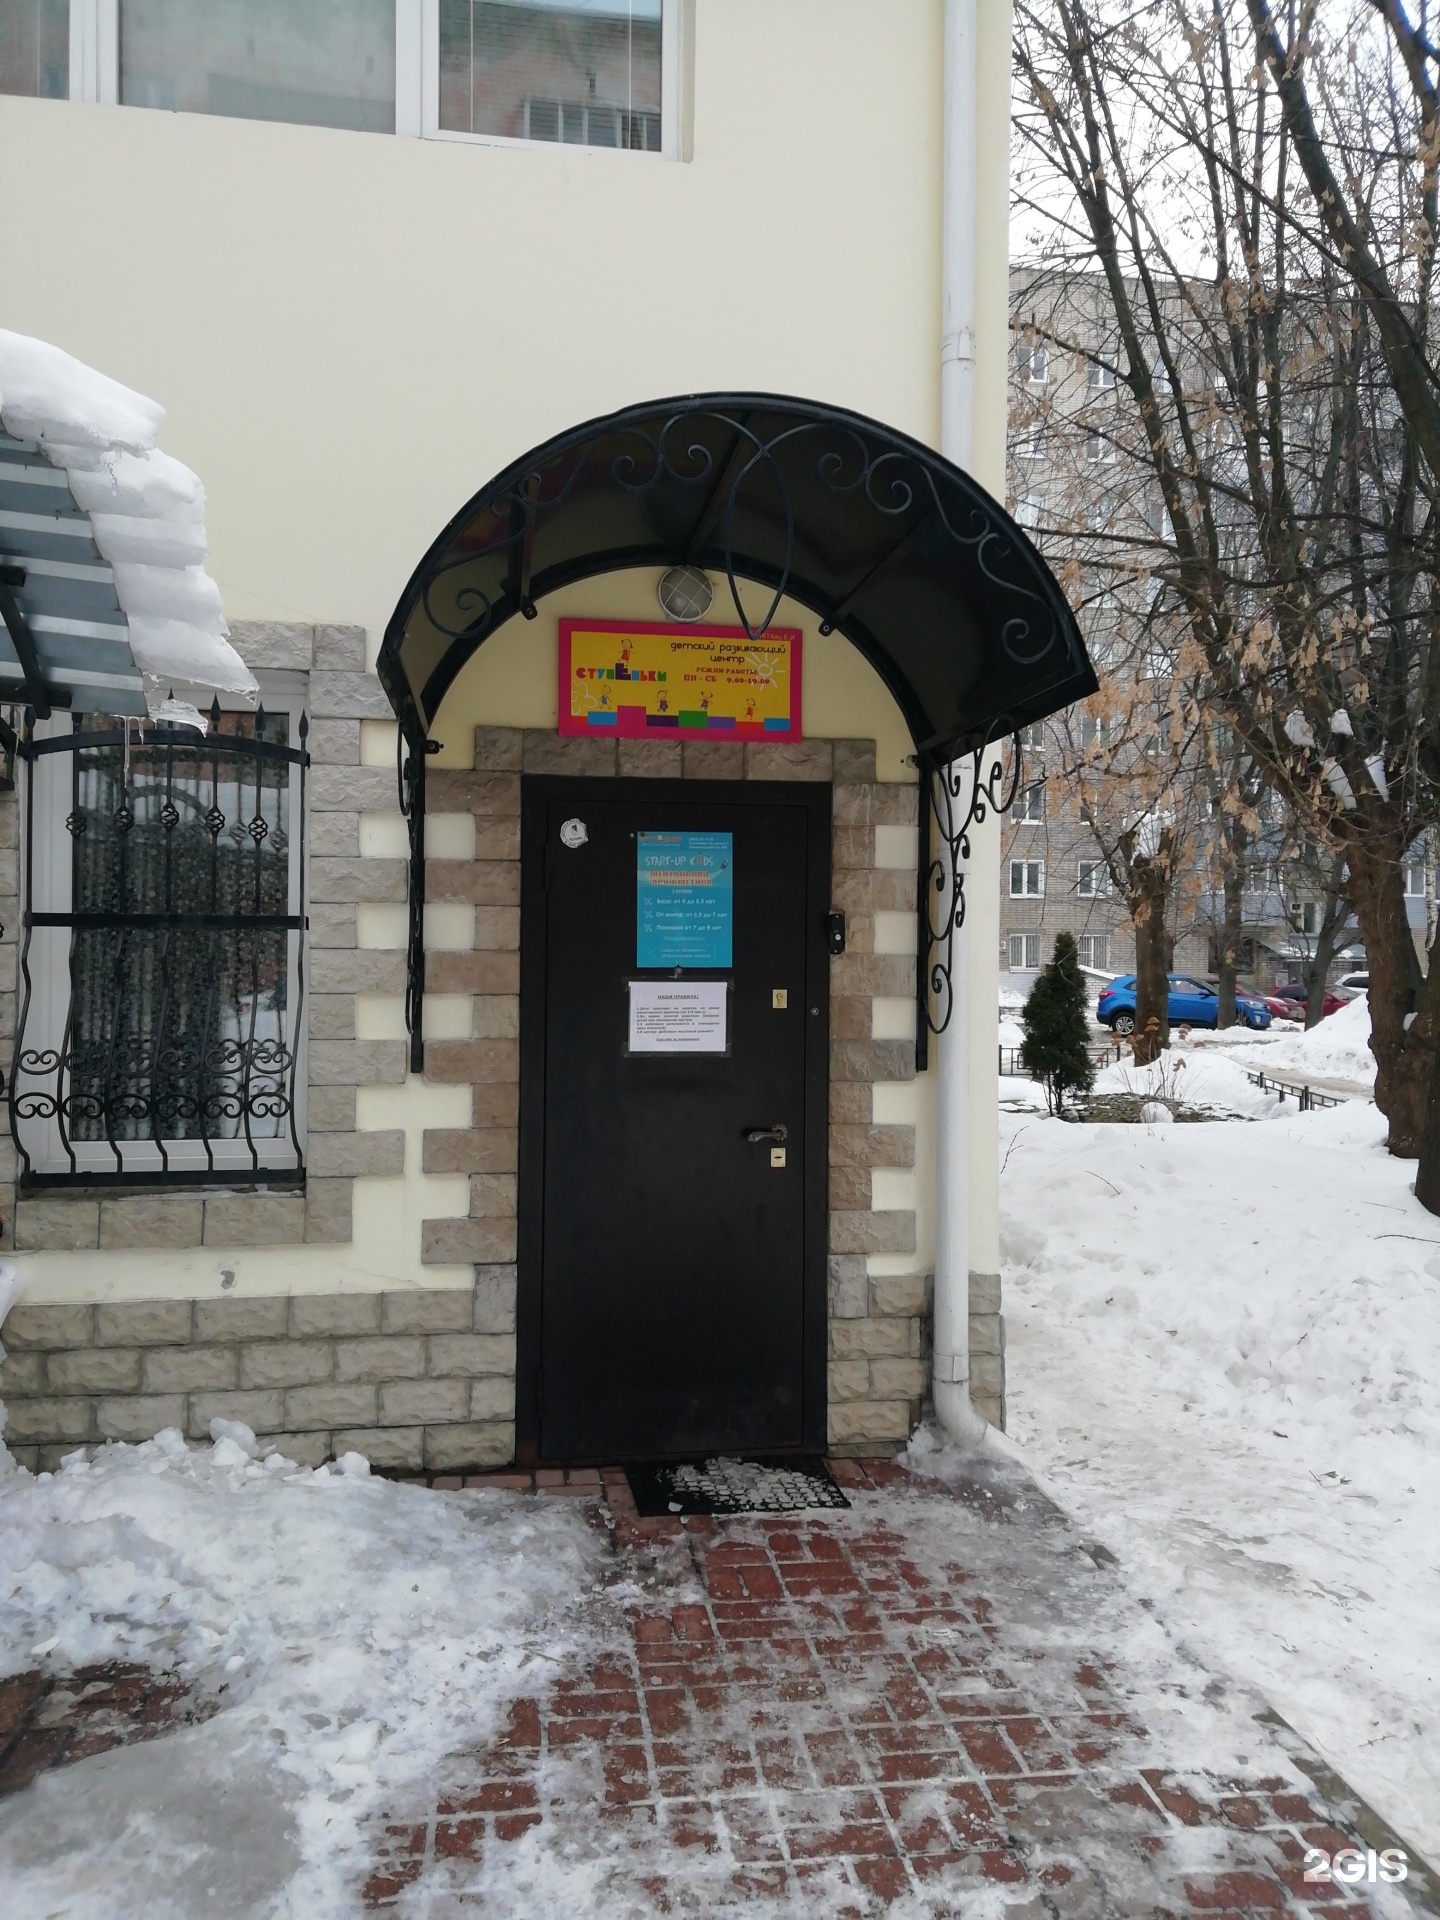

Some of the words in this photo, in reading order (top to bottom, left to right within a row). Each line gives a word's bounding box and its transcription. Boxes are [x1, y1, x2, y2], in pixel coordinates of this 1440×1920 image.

[670, 641, 715, 652] детский
[719, 644, 786, 654] развивающий
[709, 654, 745, 665] центр
[576, 662, 667, 682] СТУПЕНЬКИ
[726, 677, 770, 685] 9.00-19.00
[645, 855, 687, 867] START-UP
